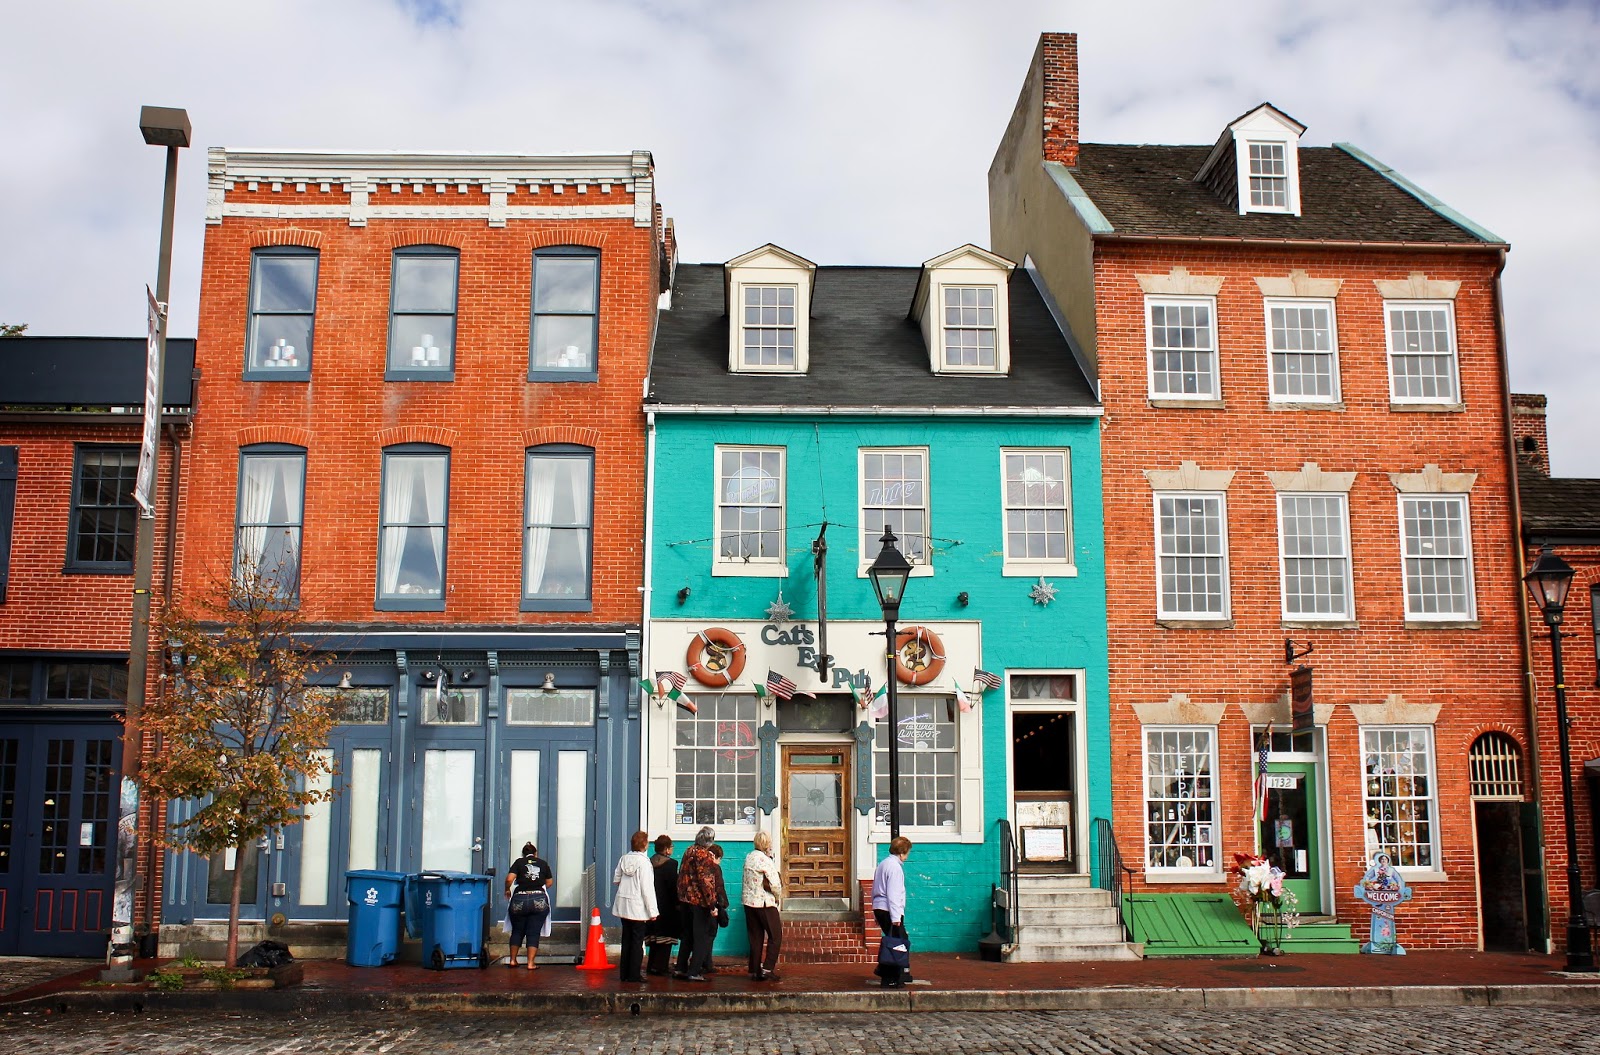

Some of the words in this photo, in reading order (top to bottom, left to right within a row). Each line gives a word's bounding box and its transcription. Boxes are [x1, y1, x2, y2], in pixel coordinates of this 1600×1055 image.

[761, 624, 814, 645] Cat's
[832, 668, 872, 689] Pub
[1271, 778, 1292, 788] 1732
[1366, 892, 1399, 902] WELCOME
